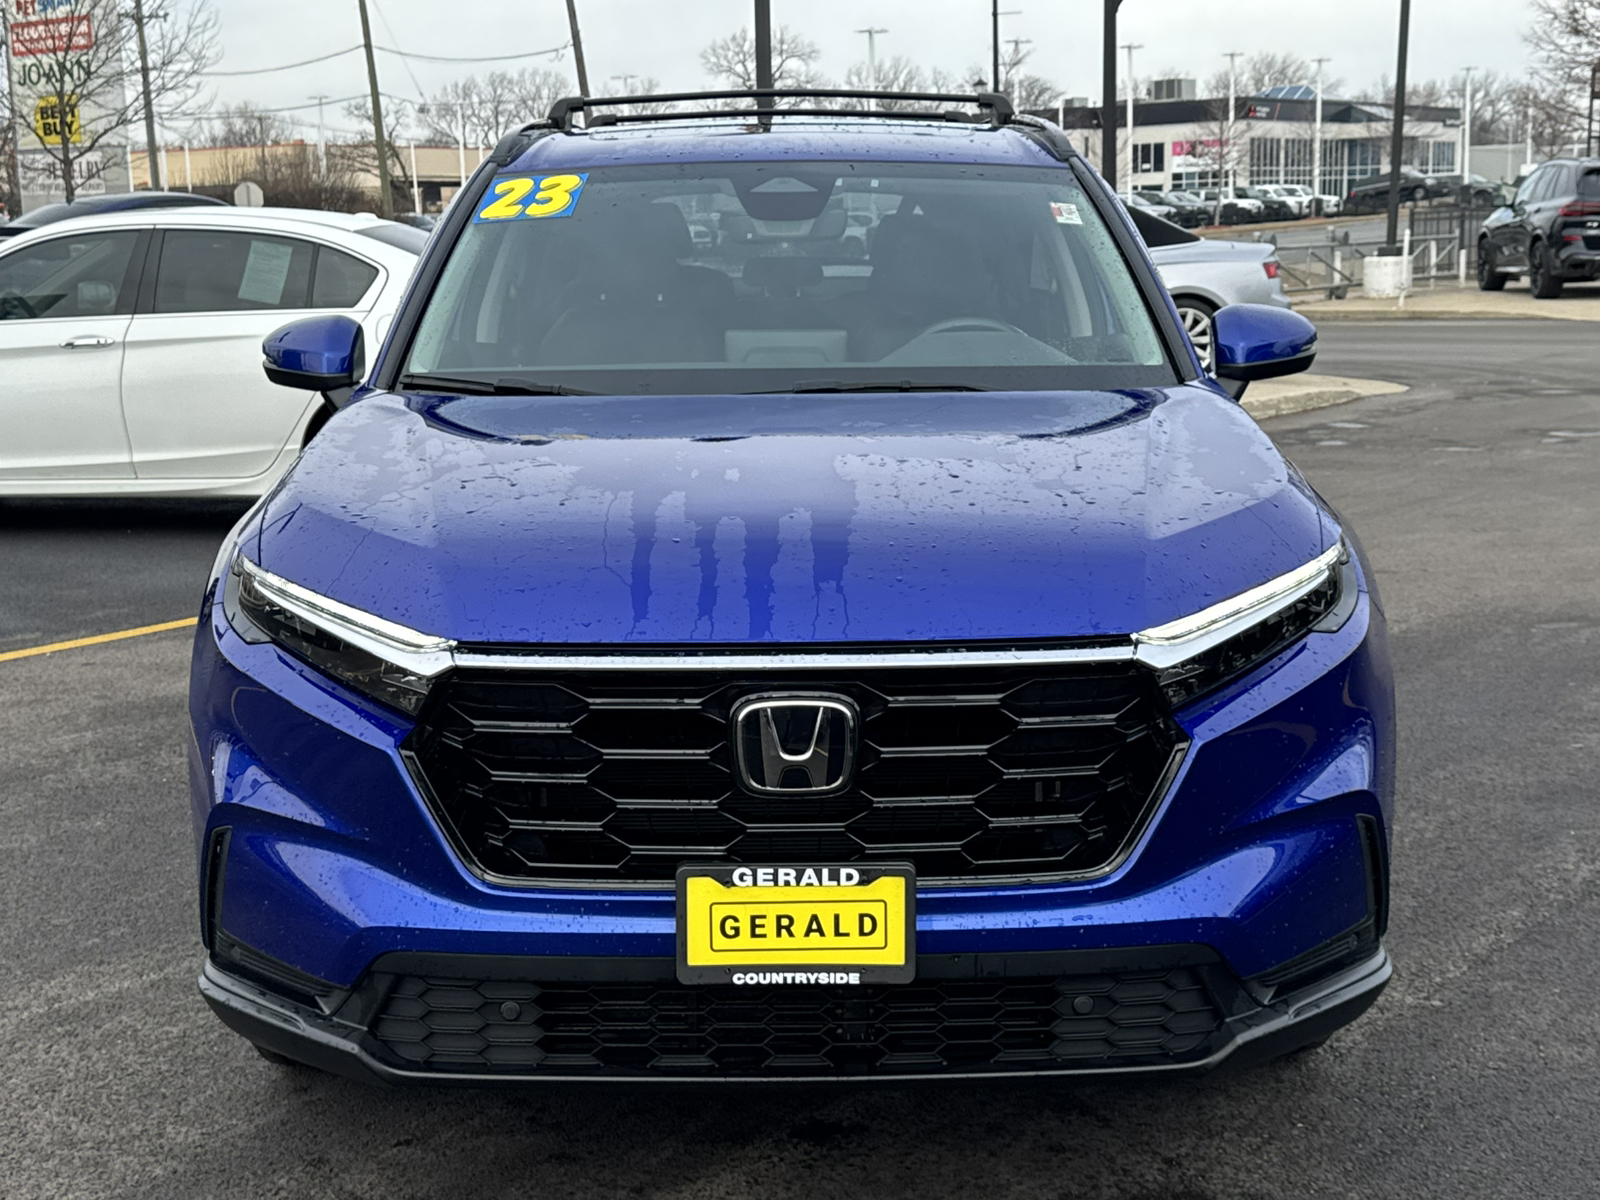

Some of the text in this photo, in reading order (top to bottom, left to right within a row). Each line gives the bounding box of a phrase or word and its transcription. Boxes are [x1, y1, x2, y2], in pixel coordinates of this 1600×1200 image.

[40, 105, 77, 121] BET
[43, 121, 75, 136] BUY
[480, 174, 582, 218] 23
[732, 867, 860, 887] GERALD
[720, 912, 878, 939] GERALD
[732, 972, 860, 985] COUNTRYSIDE
